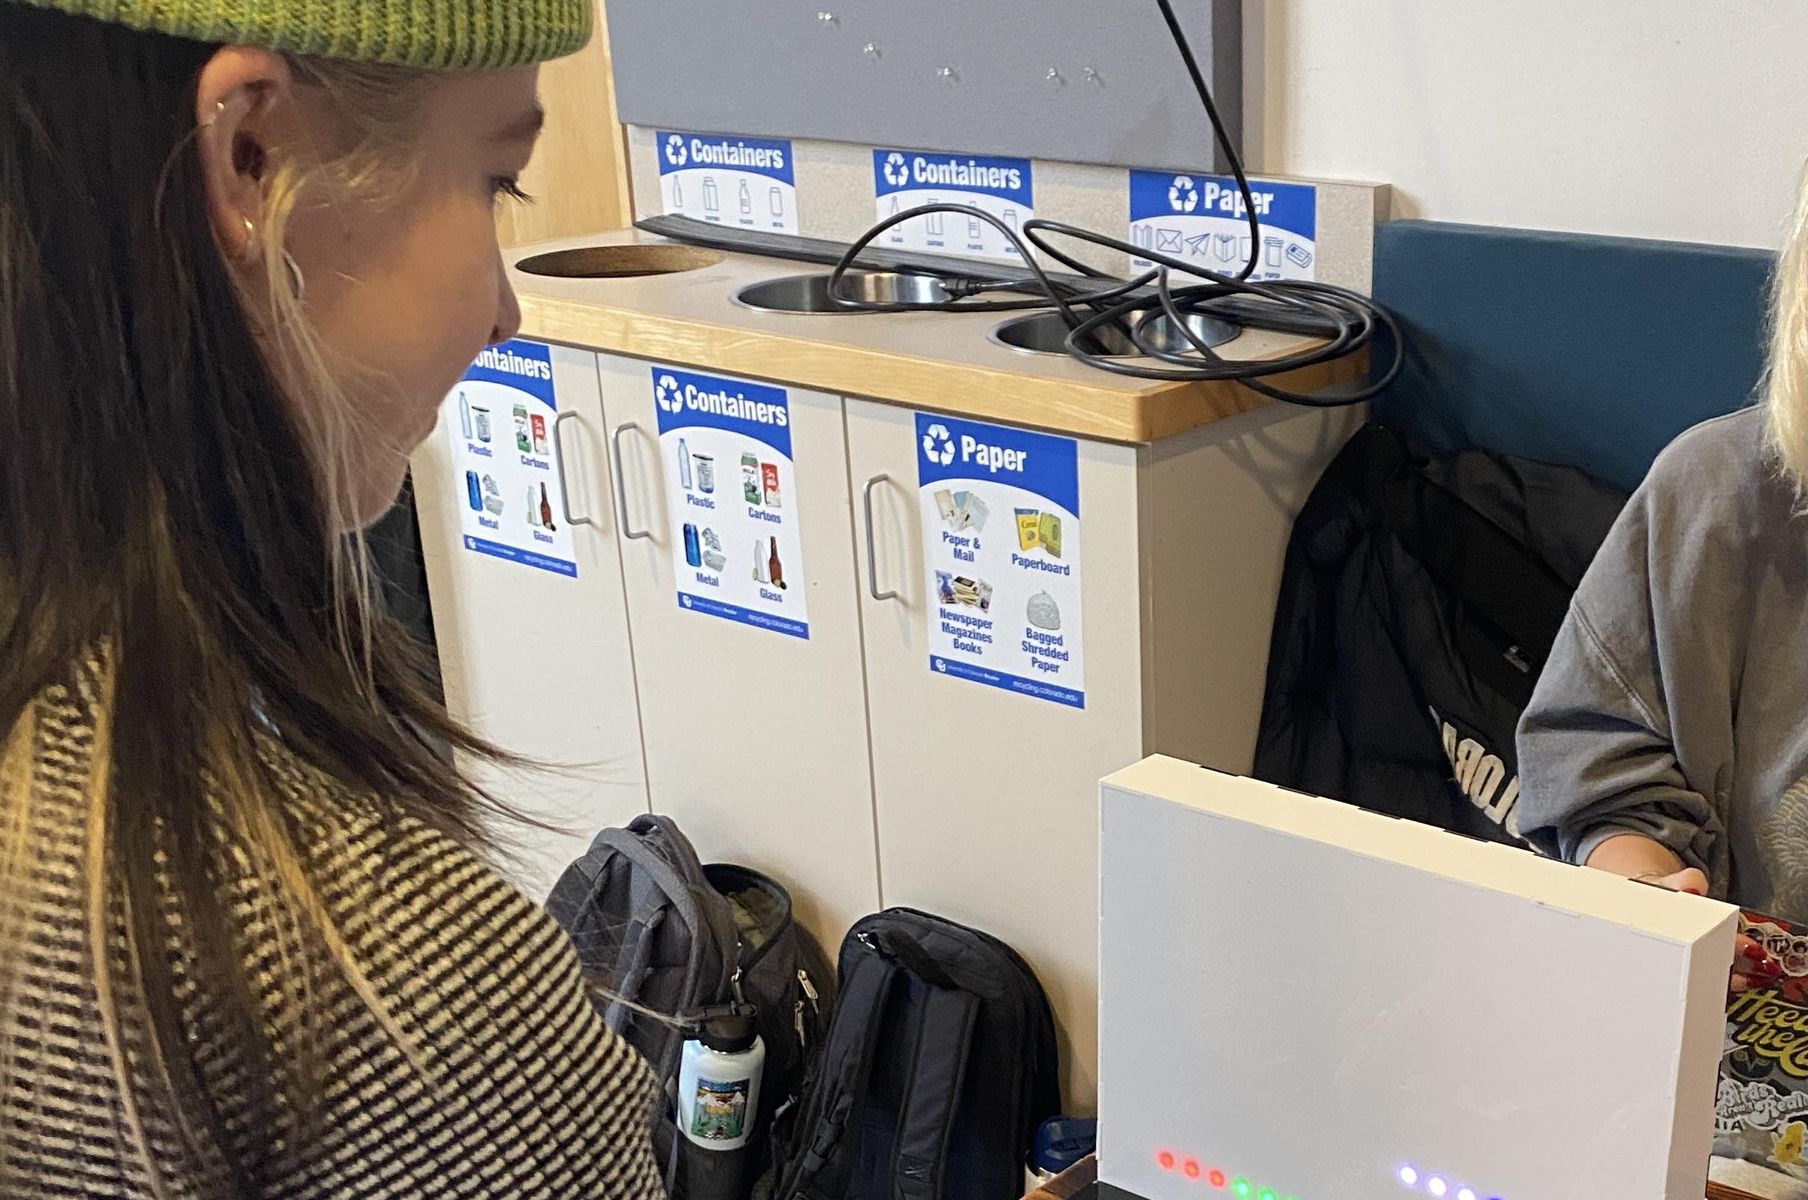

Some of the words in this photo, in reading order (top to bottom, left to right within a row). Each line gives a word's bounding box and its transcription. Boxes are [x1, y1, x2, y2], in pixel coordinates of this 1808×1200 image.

[690, 138, 784, 169] Containers
[913, 157, 1021, 190] Containers
[1204, 182, 1274, 218] Paper
[472, 347, 551, 380] ontainers
[684, 384, 788, 427] Containers
[961, 435, 1027, 473] Paper
[687, 494, 716, 510] Plastic
[748, 506, 782, 524] Cartons
[942, 531, 970, 549] Paper
[973, 536, 981, 549] &
[953, 547, 975, 562] Mail
[1012, 552, 1070, 576] Paperboard
[696, 571, 720, 587] Metal
[760, 587, 783, 602] Glass
[939, 607, 993, 630] Newspaper
[941, 621, 993, 644] Magazines
[1026, 627, 1064, 647] Bagged
[953, 637, 983, 655] Books
[1022, 641, 1069, 661] Shredded
[1031, 656, 1060, 673] Paper
